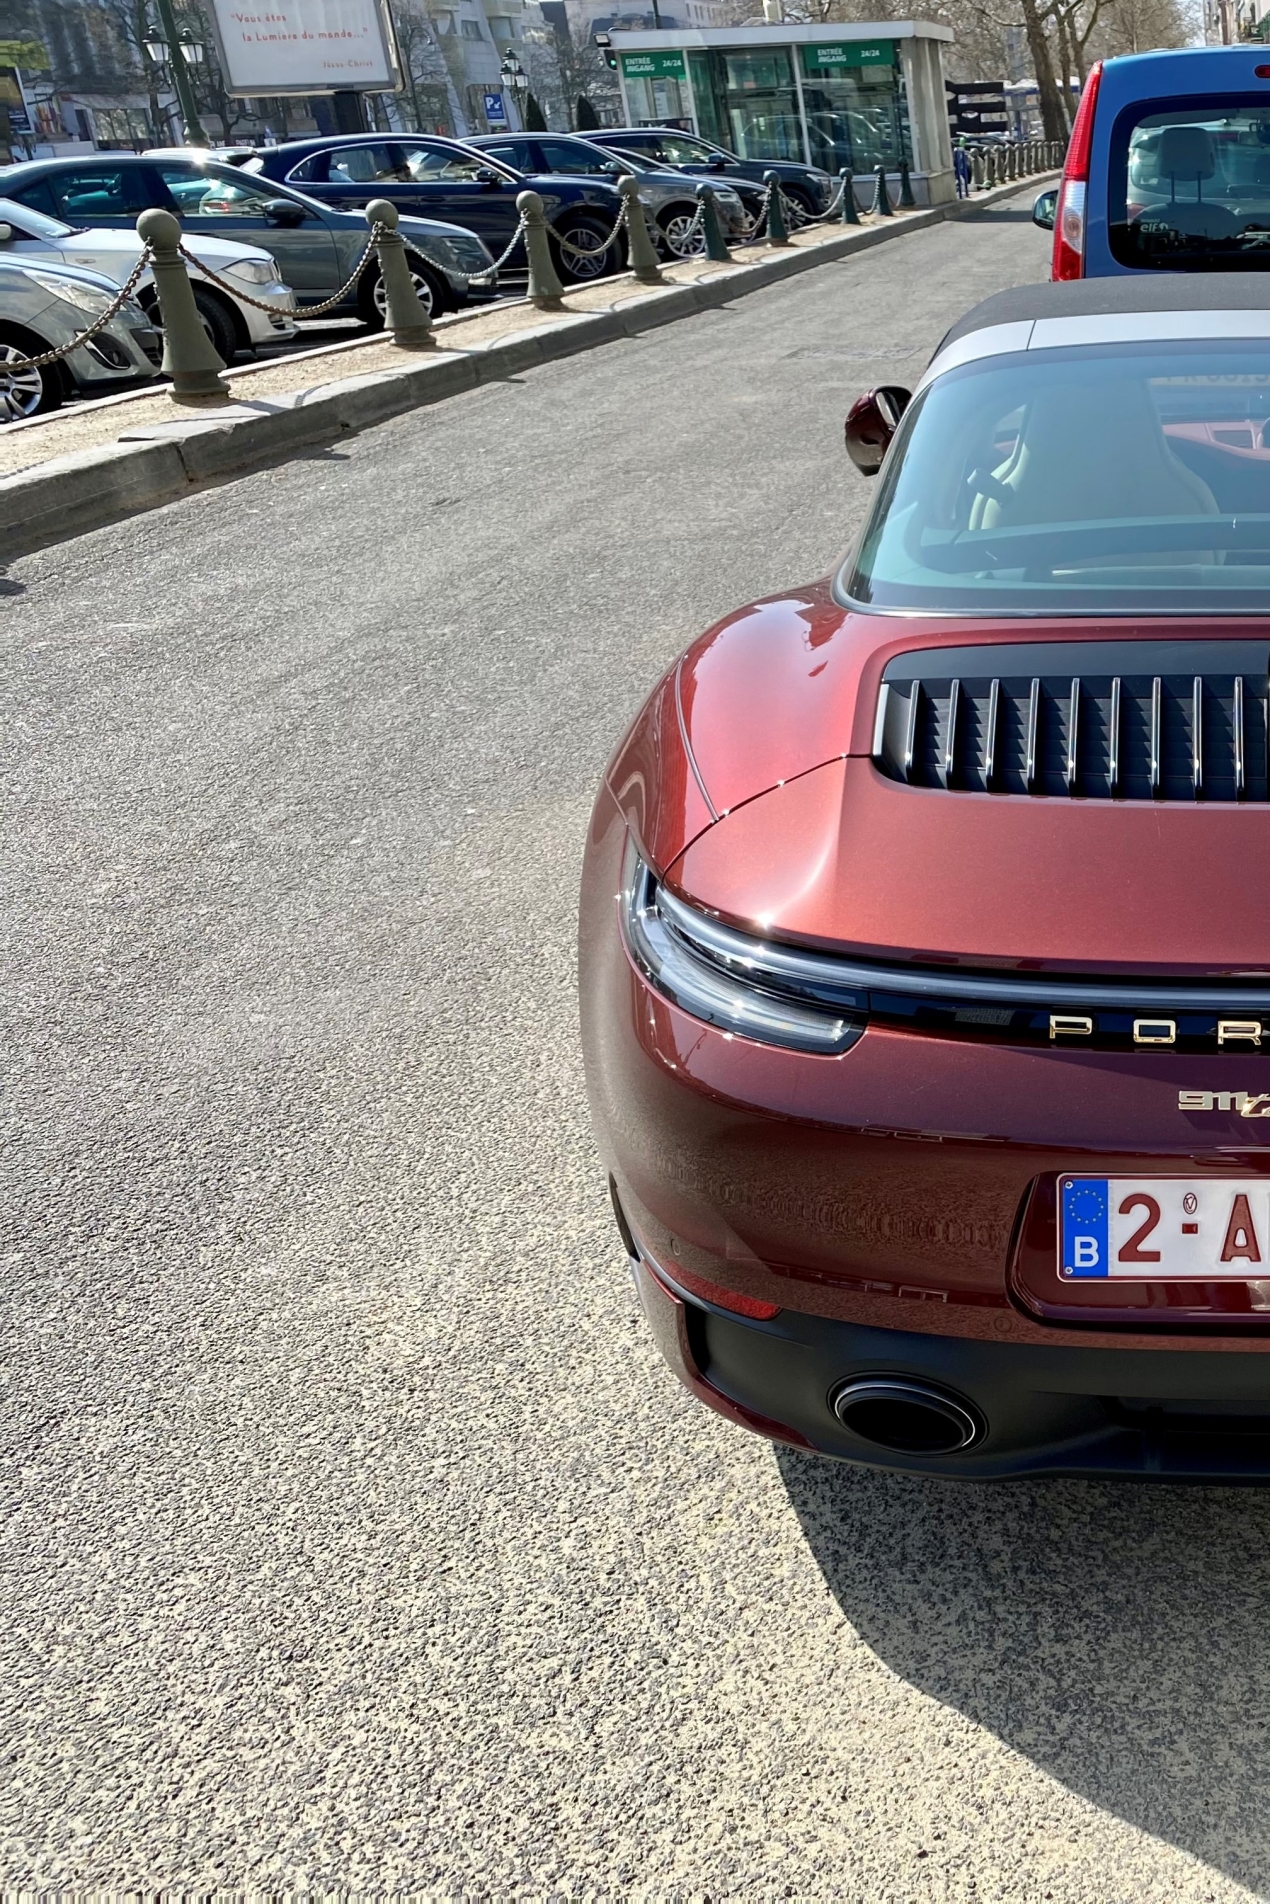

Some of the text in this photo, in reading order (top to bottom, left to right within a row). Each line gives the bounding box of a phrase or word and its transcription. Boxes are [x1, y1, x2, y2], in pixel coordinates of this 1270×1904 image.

[301, 29, 314, 40] du
[817, 47, 843, 56] ENTRÉE
[861, 49, 880, 57] 24/24
[625, 56, 651, 65] ENTRÉE
[662, 59, 682, 67] 24/24
[818, 55, 847, 63] INGANG
[485, 96, 494, 109] P
[1140, 223, 1158, 232] elf
[1178, 1091, 1248, 1110] 911
[1074, 1236, 1099, 1268] B
